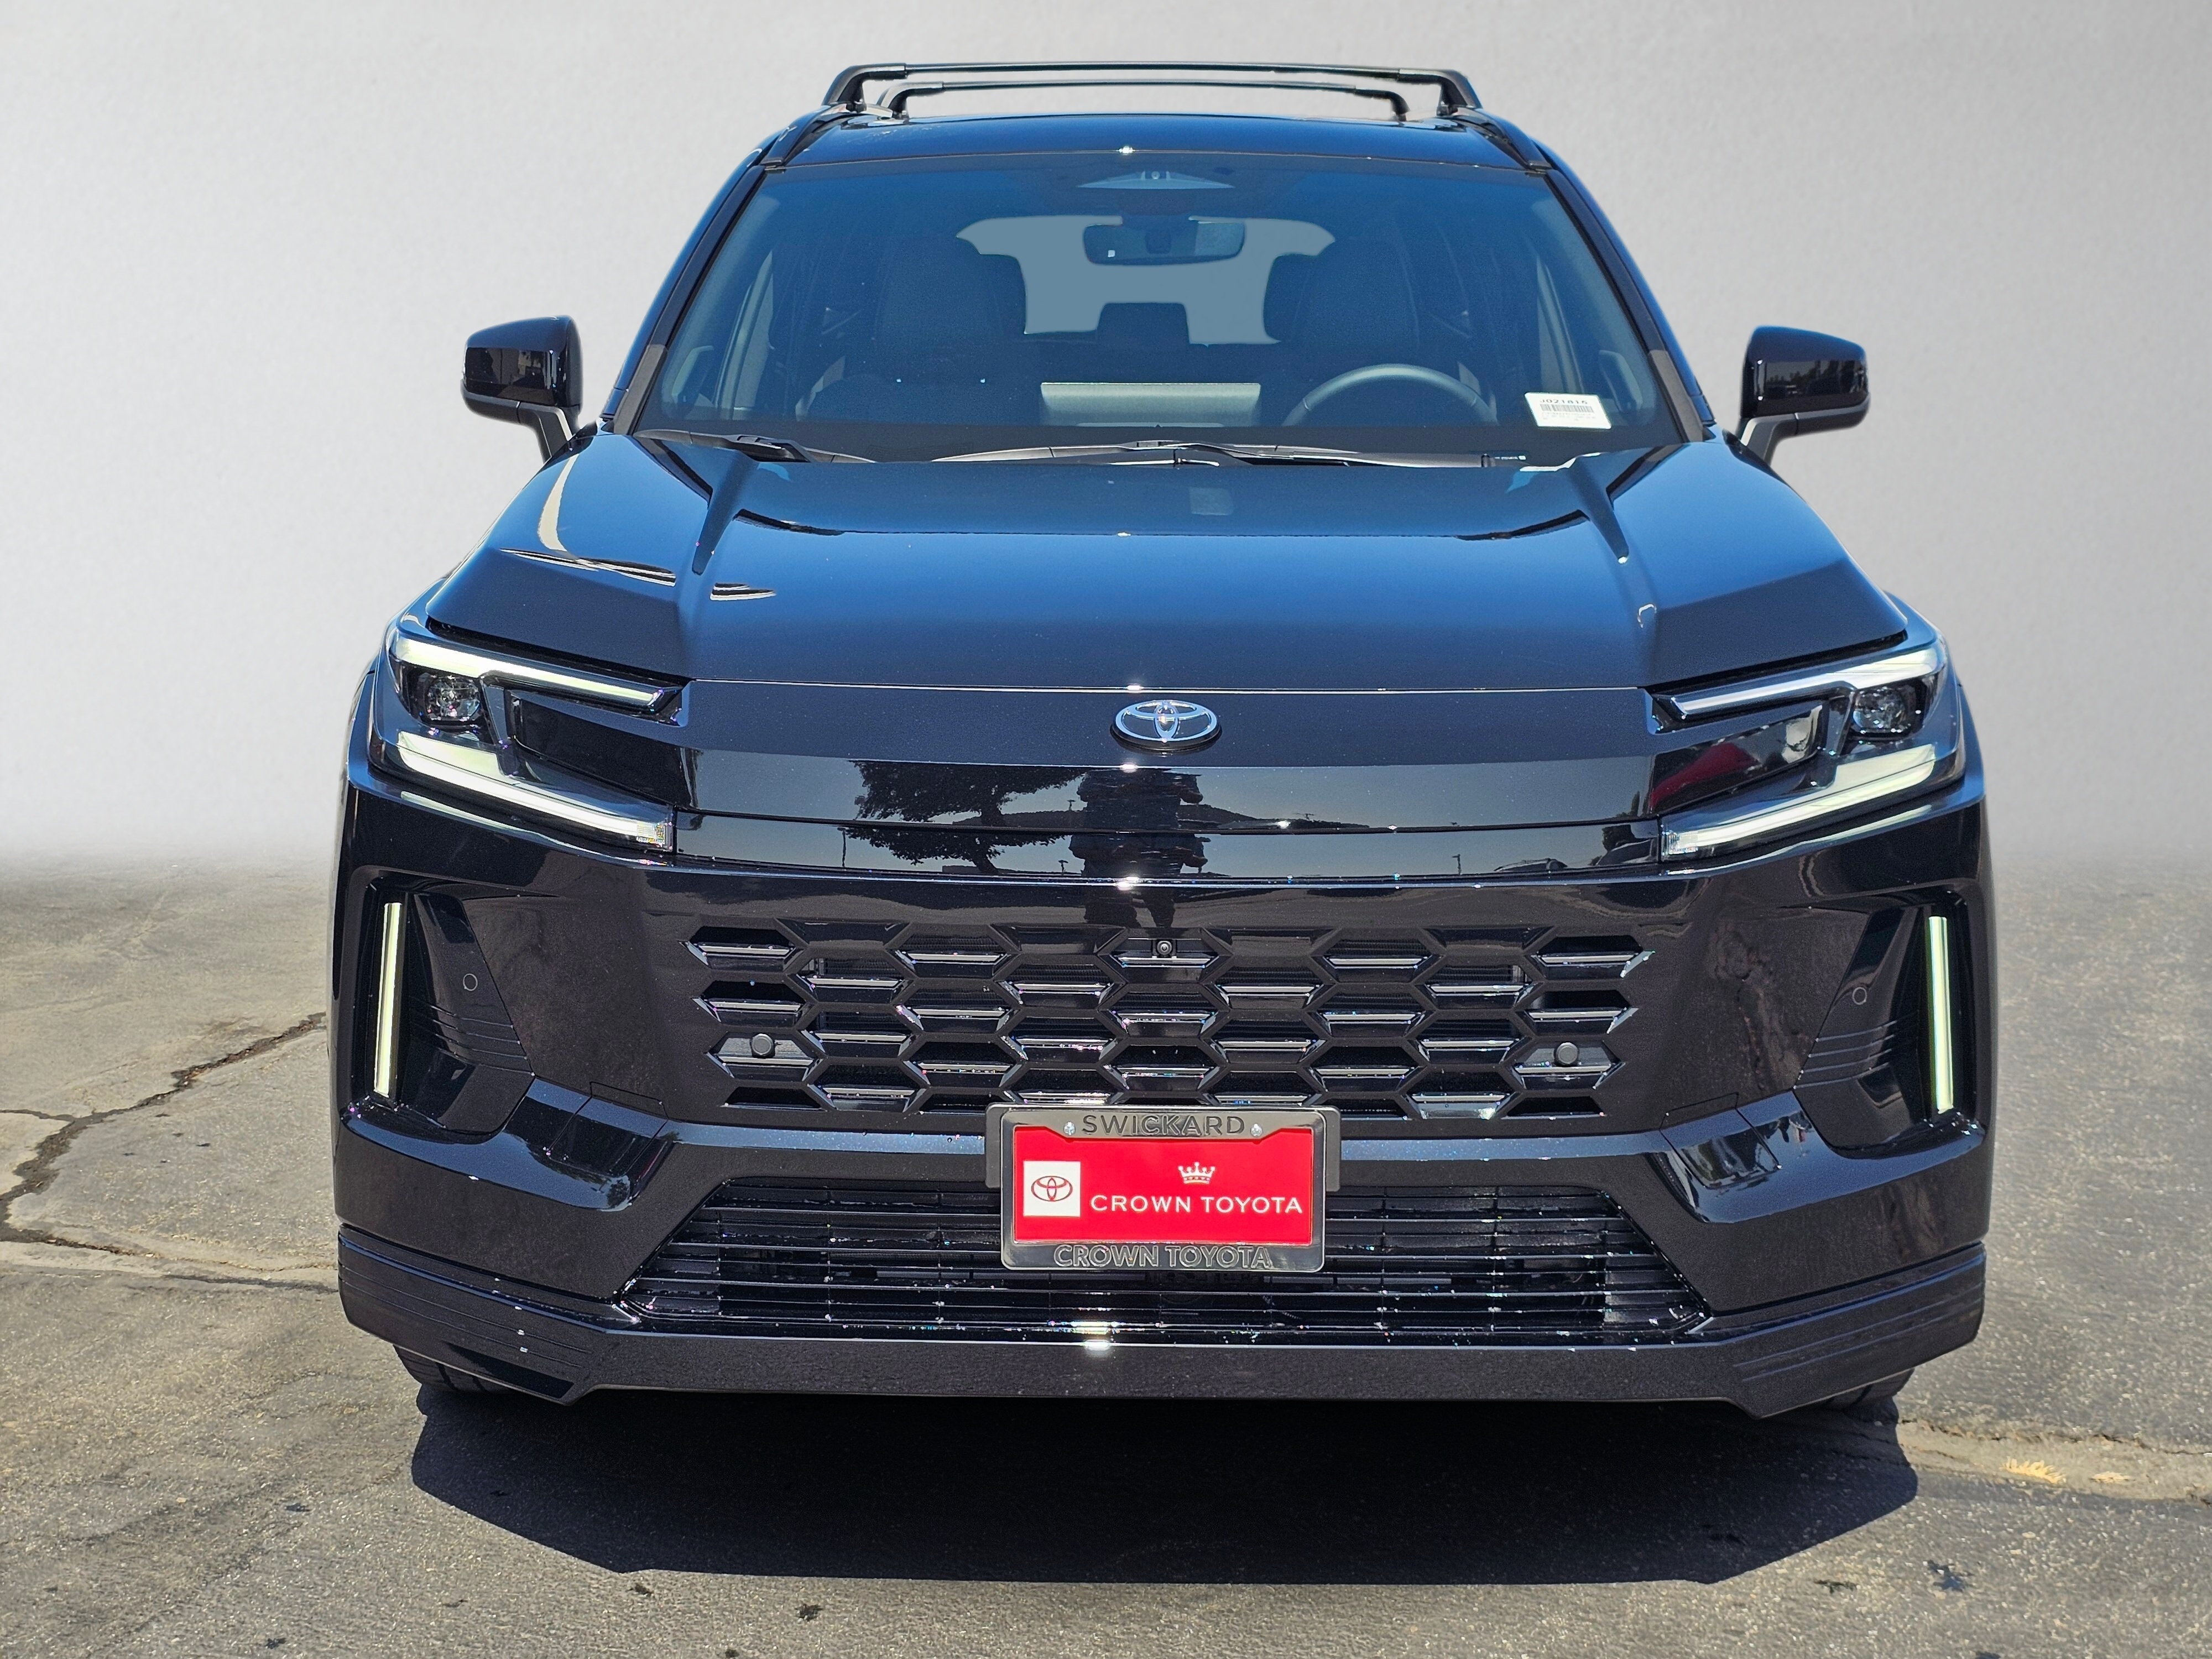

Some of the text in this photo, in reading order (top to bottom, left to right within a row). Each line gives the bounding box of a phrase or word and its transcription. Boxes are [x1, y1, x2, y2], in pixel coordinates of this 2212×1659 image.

[1082, 1114, 1245, 1135] SWICKARD
[1091, 1194, 1302, 1214] CROWN TOYOTA
[1053, 1244, 1272, 1269] CROWN TOYOTA
